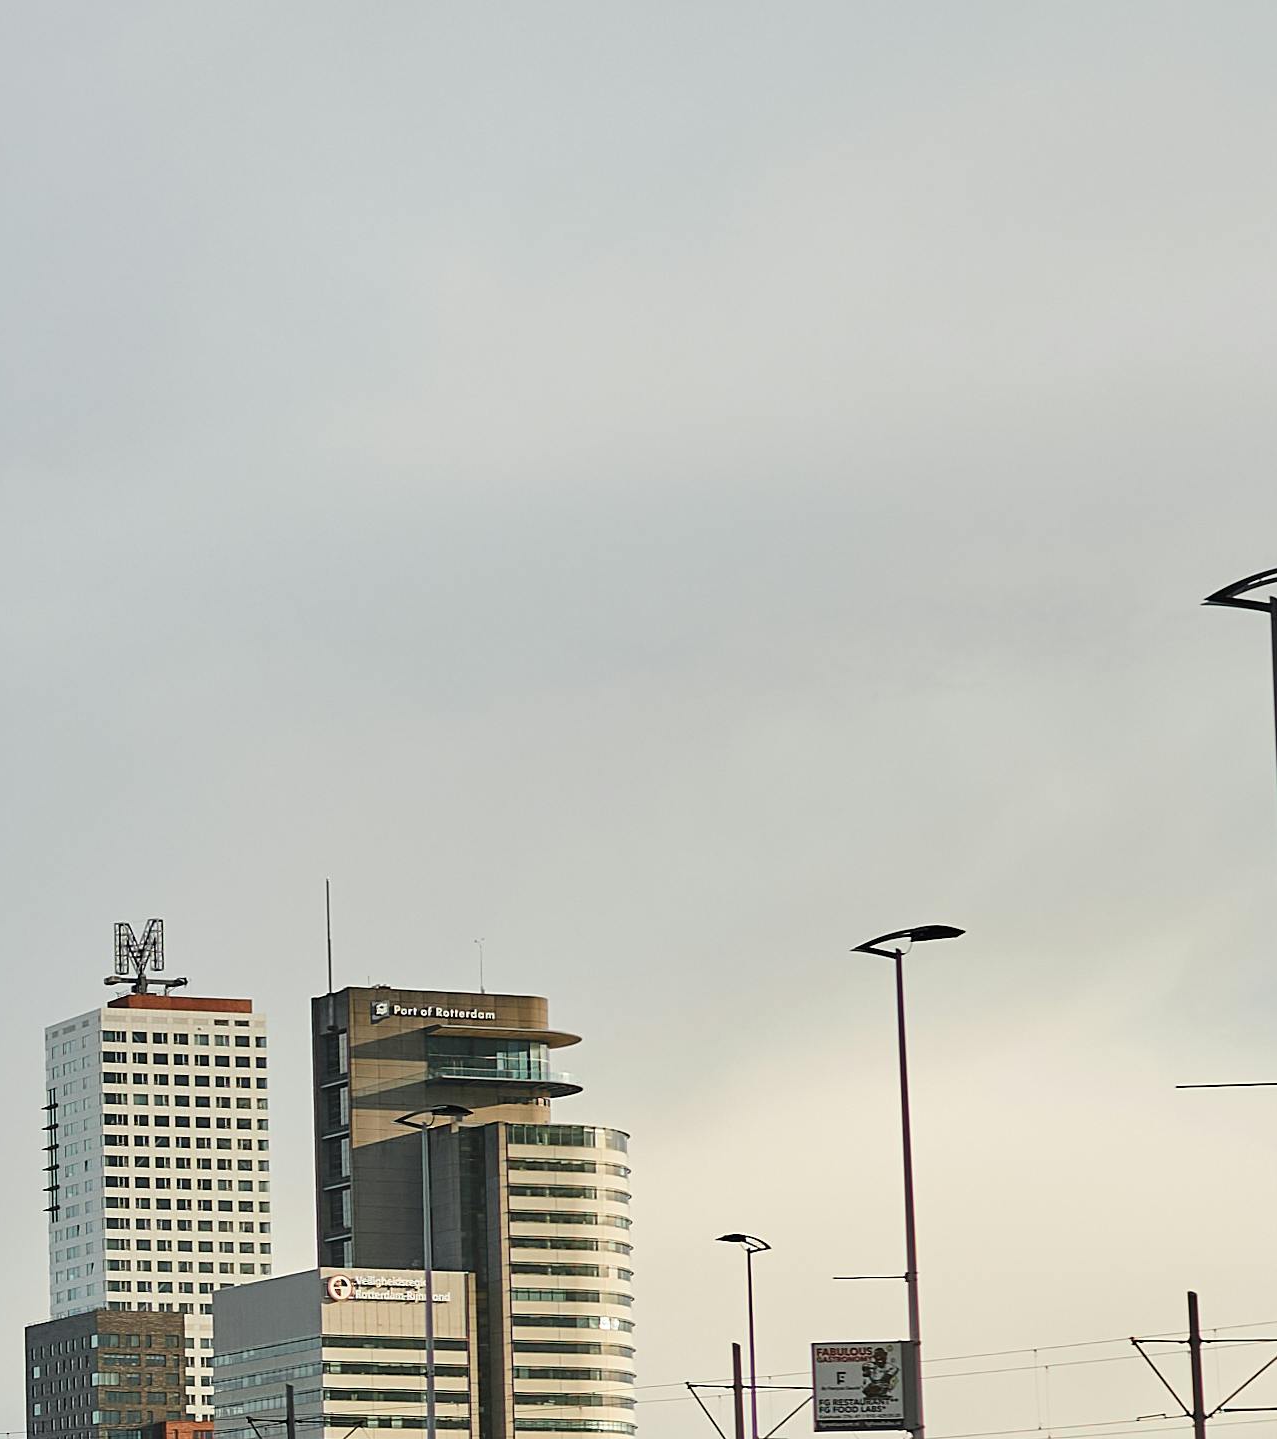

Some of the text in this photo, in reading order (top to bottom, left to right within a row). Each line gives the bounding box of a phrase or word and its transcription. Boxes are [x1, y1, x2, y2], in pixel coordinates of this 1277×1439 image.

[393, 1004, 496, 1020] Port of Rotterdam
[816, 1347, 872, 1356] FABULOUS
[833, 1406, 859, 1414] FOOD
